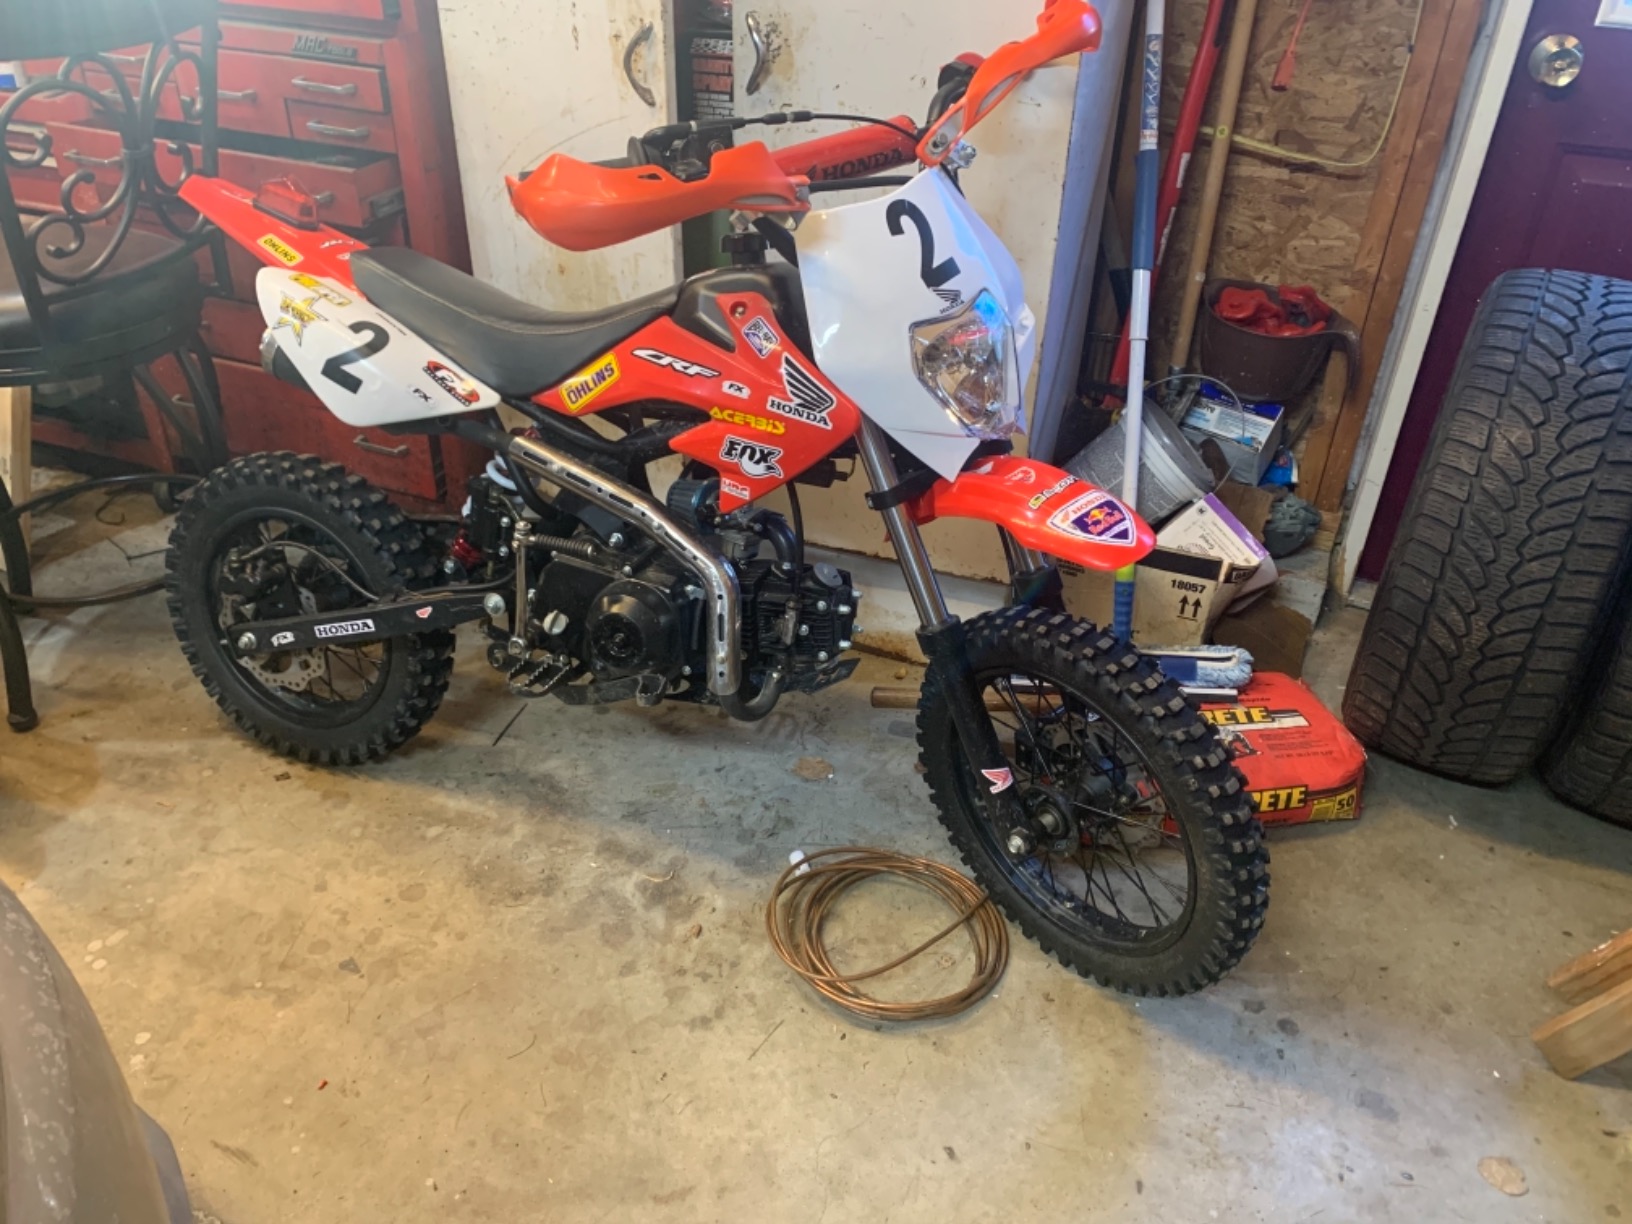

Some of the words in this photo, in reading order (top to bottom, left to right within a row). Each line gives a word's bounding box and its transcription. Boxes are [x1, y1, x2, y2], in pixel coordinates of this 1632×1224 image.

[822, 149, 904, 180] HONDA
[886, 199, 961, 288] 2
[320, 321, 390, 394] 2
[631, 348, 721, 378] CRF
[413, 388, 432, 402] FX
[728, 383, 745, 393] FX
[709, 406, 785, 435] ACERBIS
[769, 399, 830, 427] HONDA
[722, 439, 781, 466] FOX
[1171, 579, 1207, 594] 18057
[316, 621, 372, 636] HONDA
[1335, 795, 1355, 811] 50
